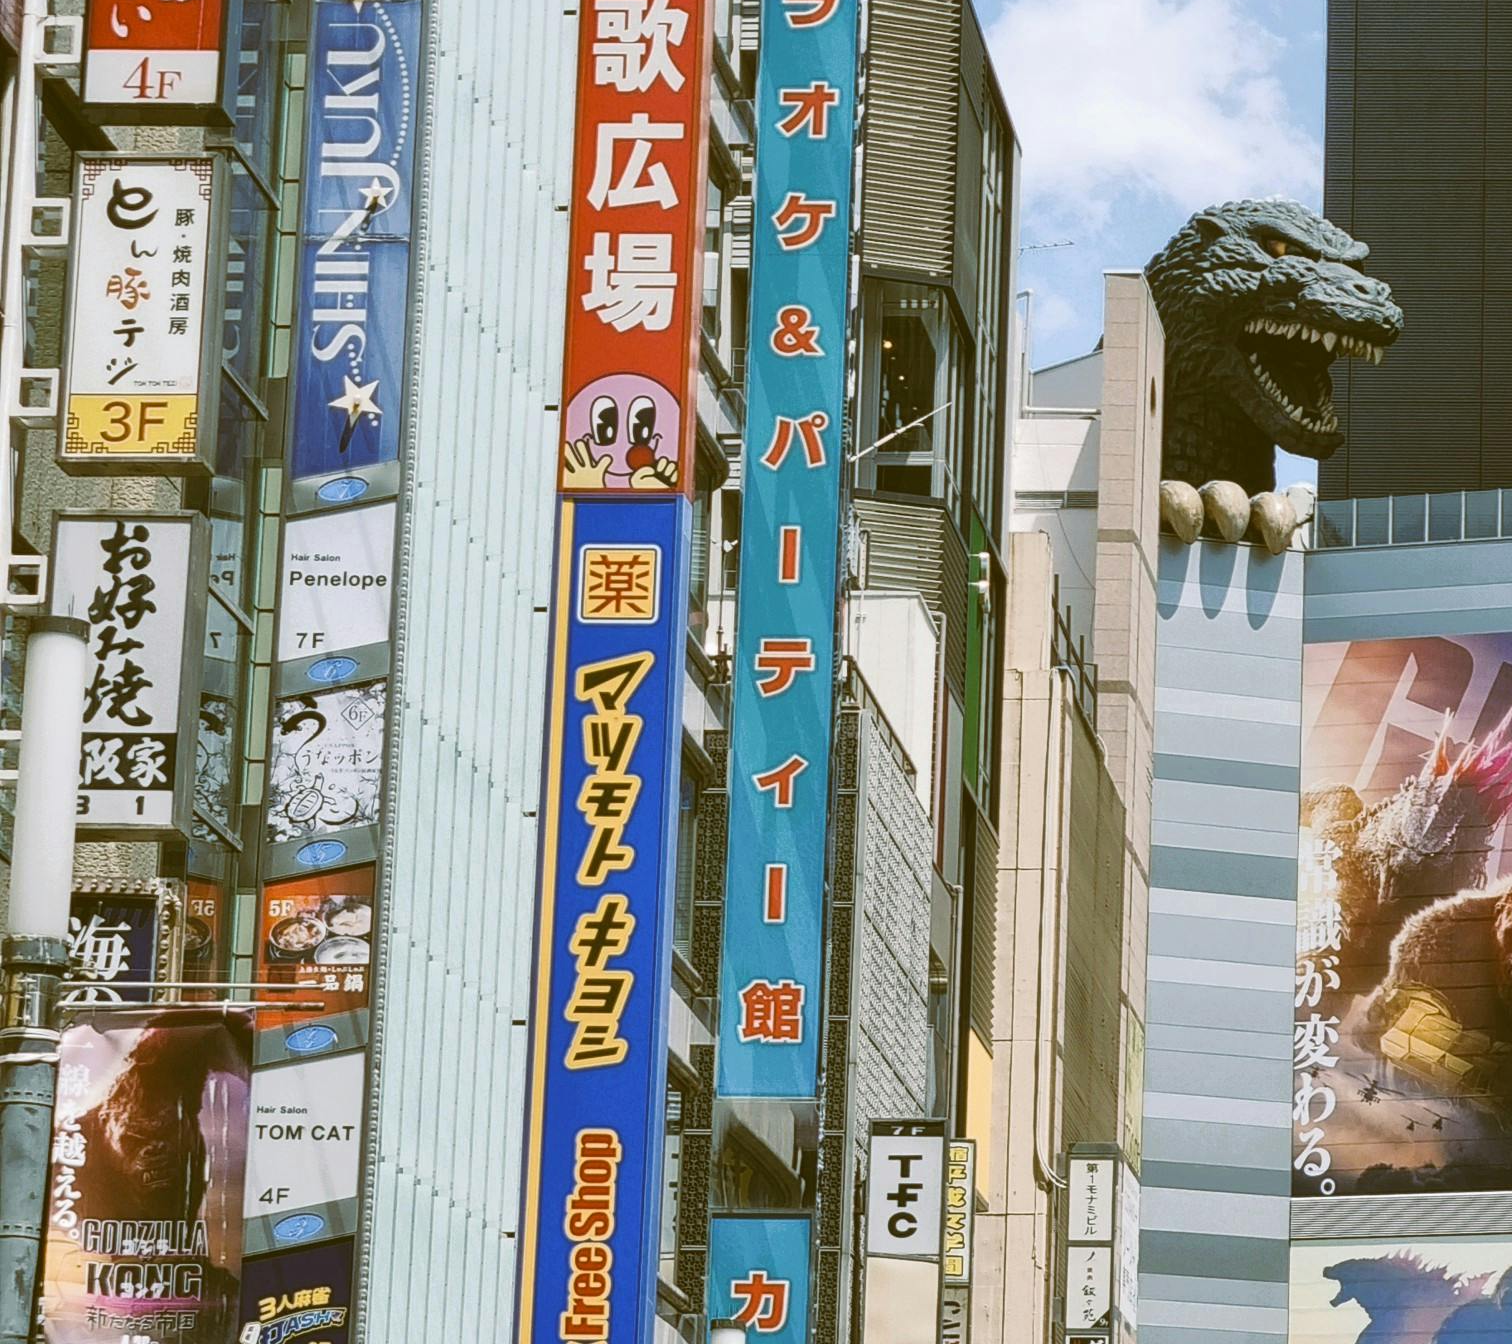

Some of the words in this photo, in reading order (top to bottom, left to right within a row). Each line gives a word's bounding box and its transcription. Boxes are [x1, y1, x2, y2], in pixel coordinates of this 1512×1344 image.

[122, 57, 182, 100] 4F
[312, 22, 401, 364] SHINJUKU
[167, 207, 196, 336] 豚・焼肉酒房
[99, 401, 169, 444] 3F
[289, 570, 388, 588] Penelope
[588, 553, 652, 614] 薬
[84, 520, 157, 727] お好み焼
[296, 632, 325, 649] 7F
[348, 706, 368, 722] 6F
[564, 651, 654, 1069] マツモトキヨシ
[268, 899, 295, 916] 5F
[257, 1106, 276, 1114] Hair
[280, 1106, 308, 1114] Salon
[890, 1126, 926, 1136] 7F
[256, 1125, 303, 1141] TOM
[311, 1124, 355, 1141] CAT
[259, 1188, 290, 1205] 4F
[566, 1127, 623, 1241] Shop
[887, 1154, 924, 1239] TFC
[1084, 1163, 1099, 1236] 第1モナミビル
[82, 1219, 209, 1256] GODZILLA
[86, 1263, 203, 1301] KONG
[560, 1242, 613, 1342] Free
